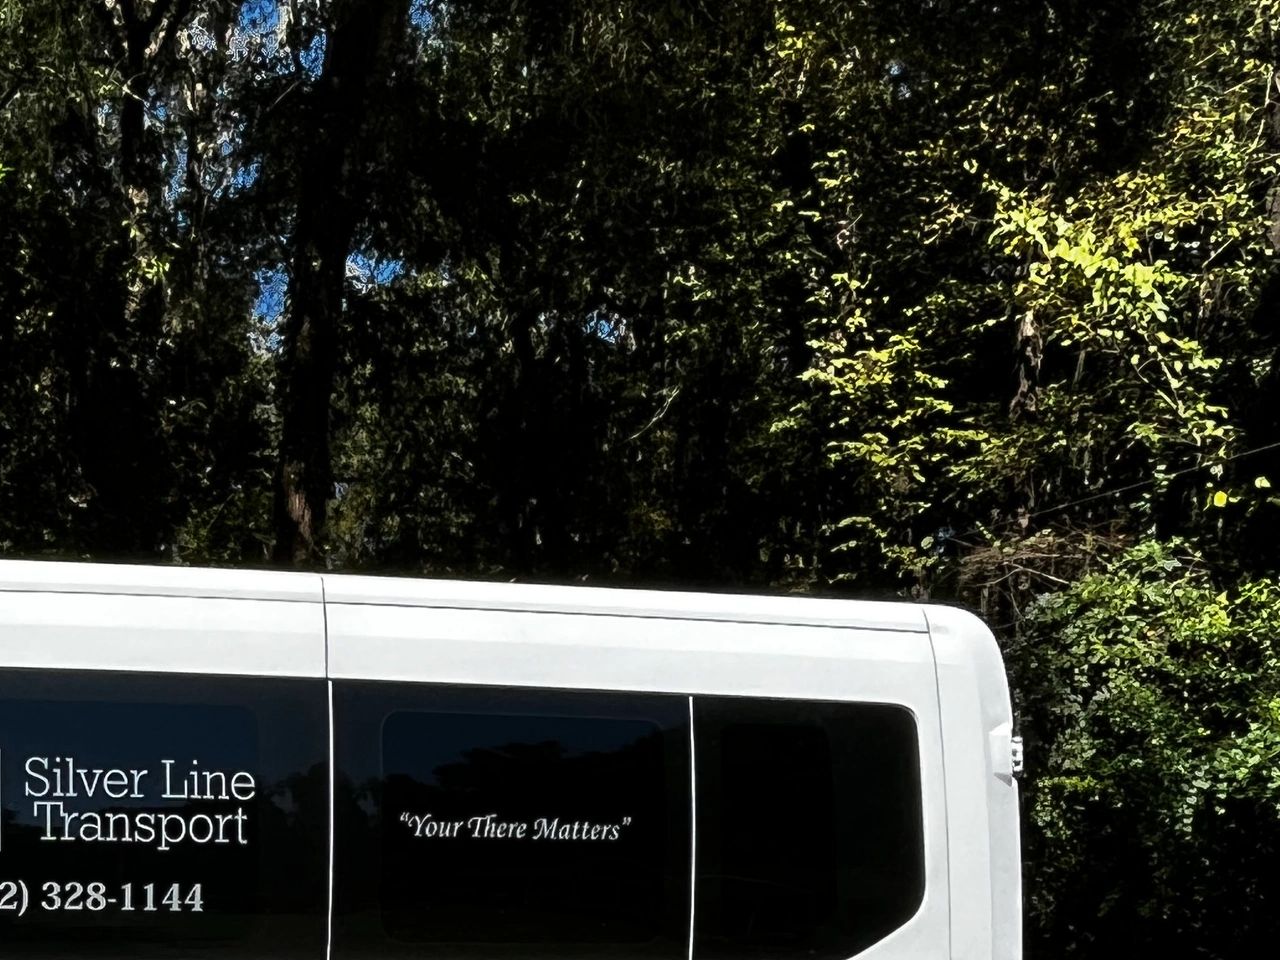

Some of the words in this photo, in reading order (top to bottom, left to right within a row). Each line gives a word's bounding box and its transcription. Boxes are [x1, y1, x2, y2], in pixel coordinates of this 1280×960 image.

[24, 756, 148, 799] Silver
[160, 758, 256, 801] Line
[32, 801, 249, 851] Transport
[399, 811, 464, 838] “Your
[467, 813, 527, 839] There
[531, 816, 632, 841] Matters”
[40, 881, 204, 913] 328-1144
